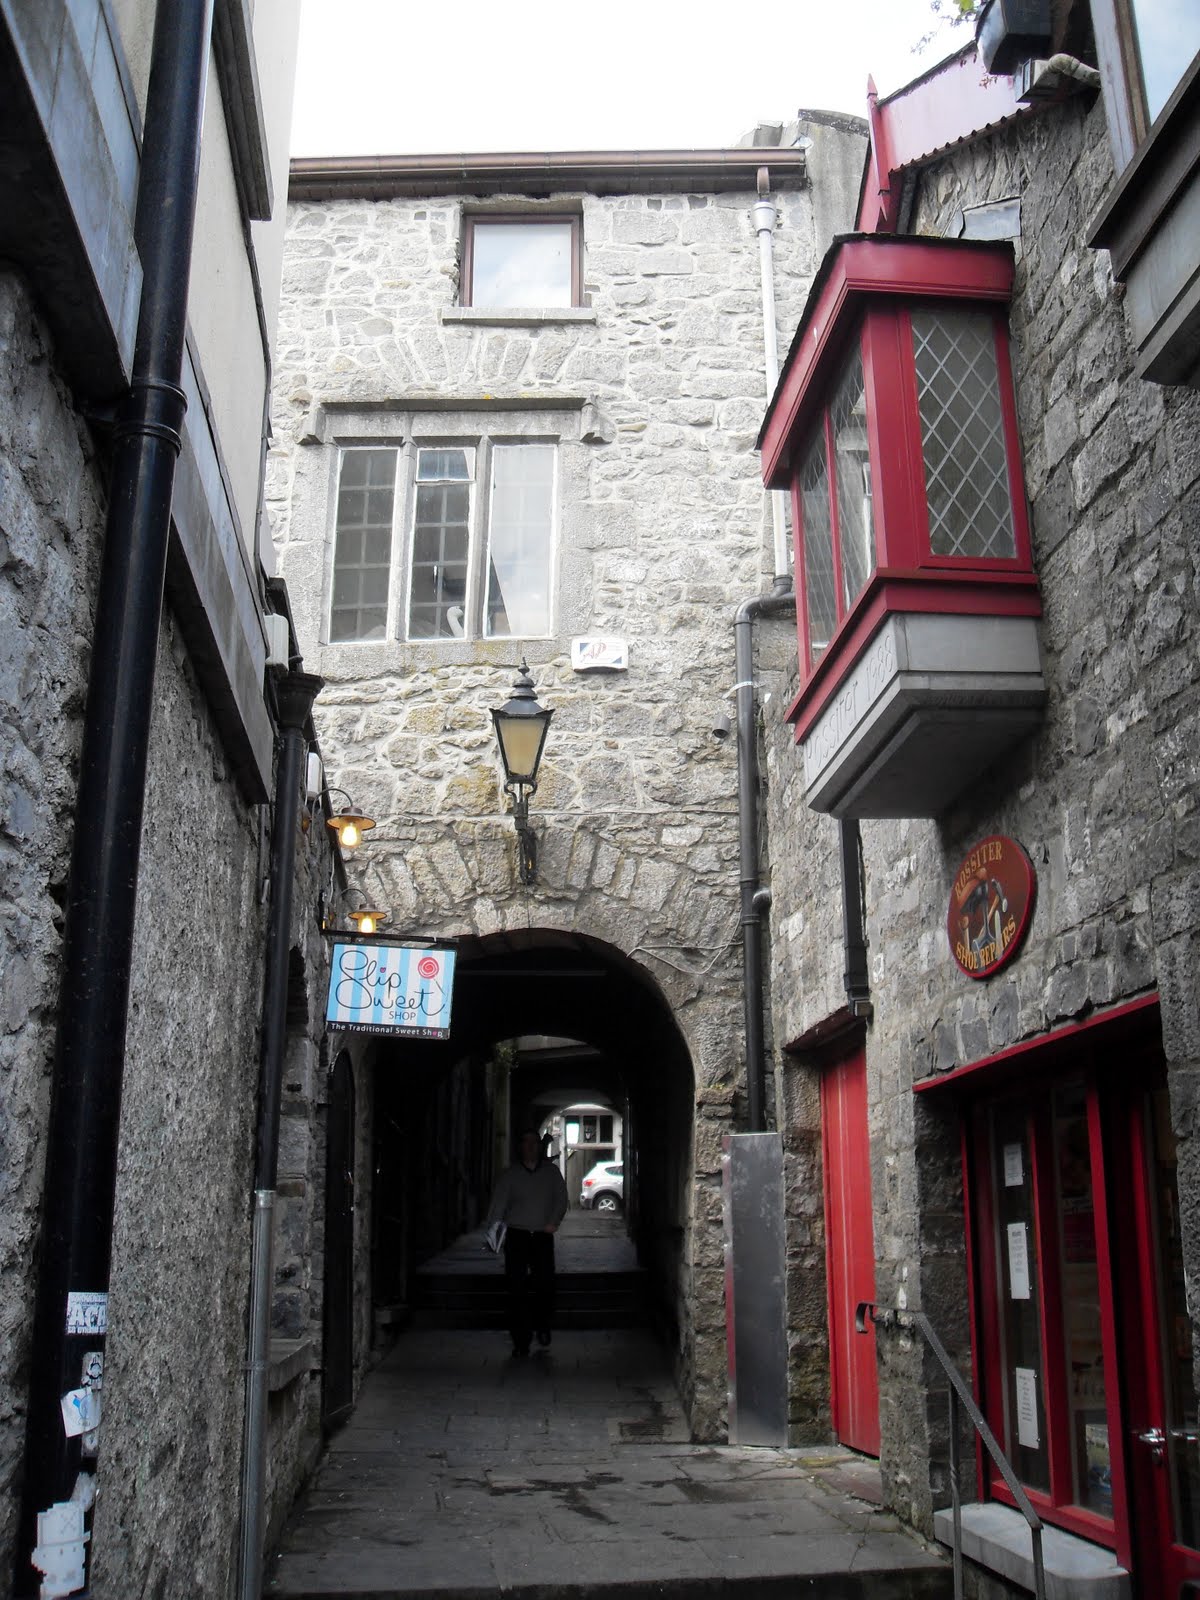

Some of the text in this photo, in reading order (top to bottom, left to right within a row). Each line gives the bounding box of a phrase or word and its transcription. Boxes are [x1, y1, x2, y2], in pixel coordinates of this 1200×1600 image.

[954, 840, 1003, 899] ROSSITER
[956, 915, 1016, 970] SHOE REPAIRS
[335, 979, 446, 1017] Sweet
[388, 1010, 417, 1021] SHOP
[331, 1023, 443, 1038] The Traditional Sweet Shop
